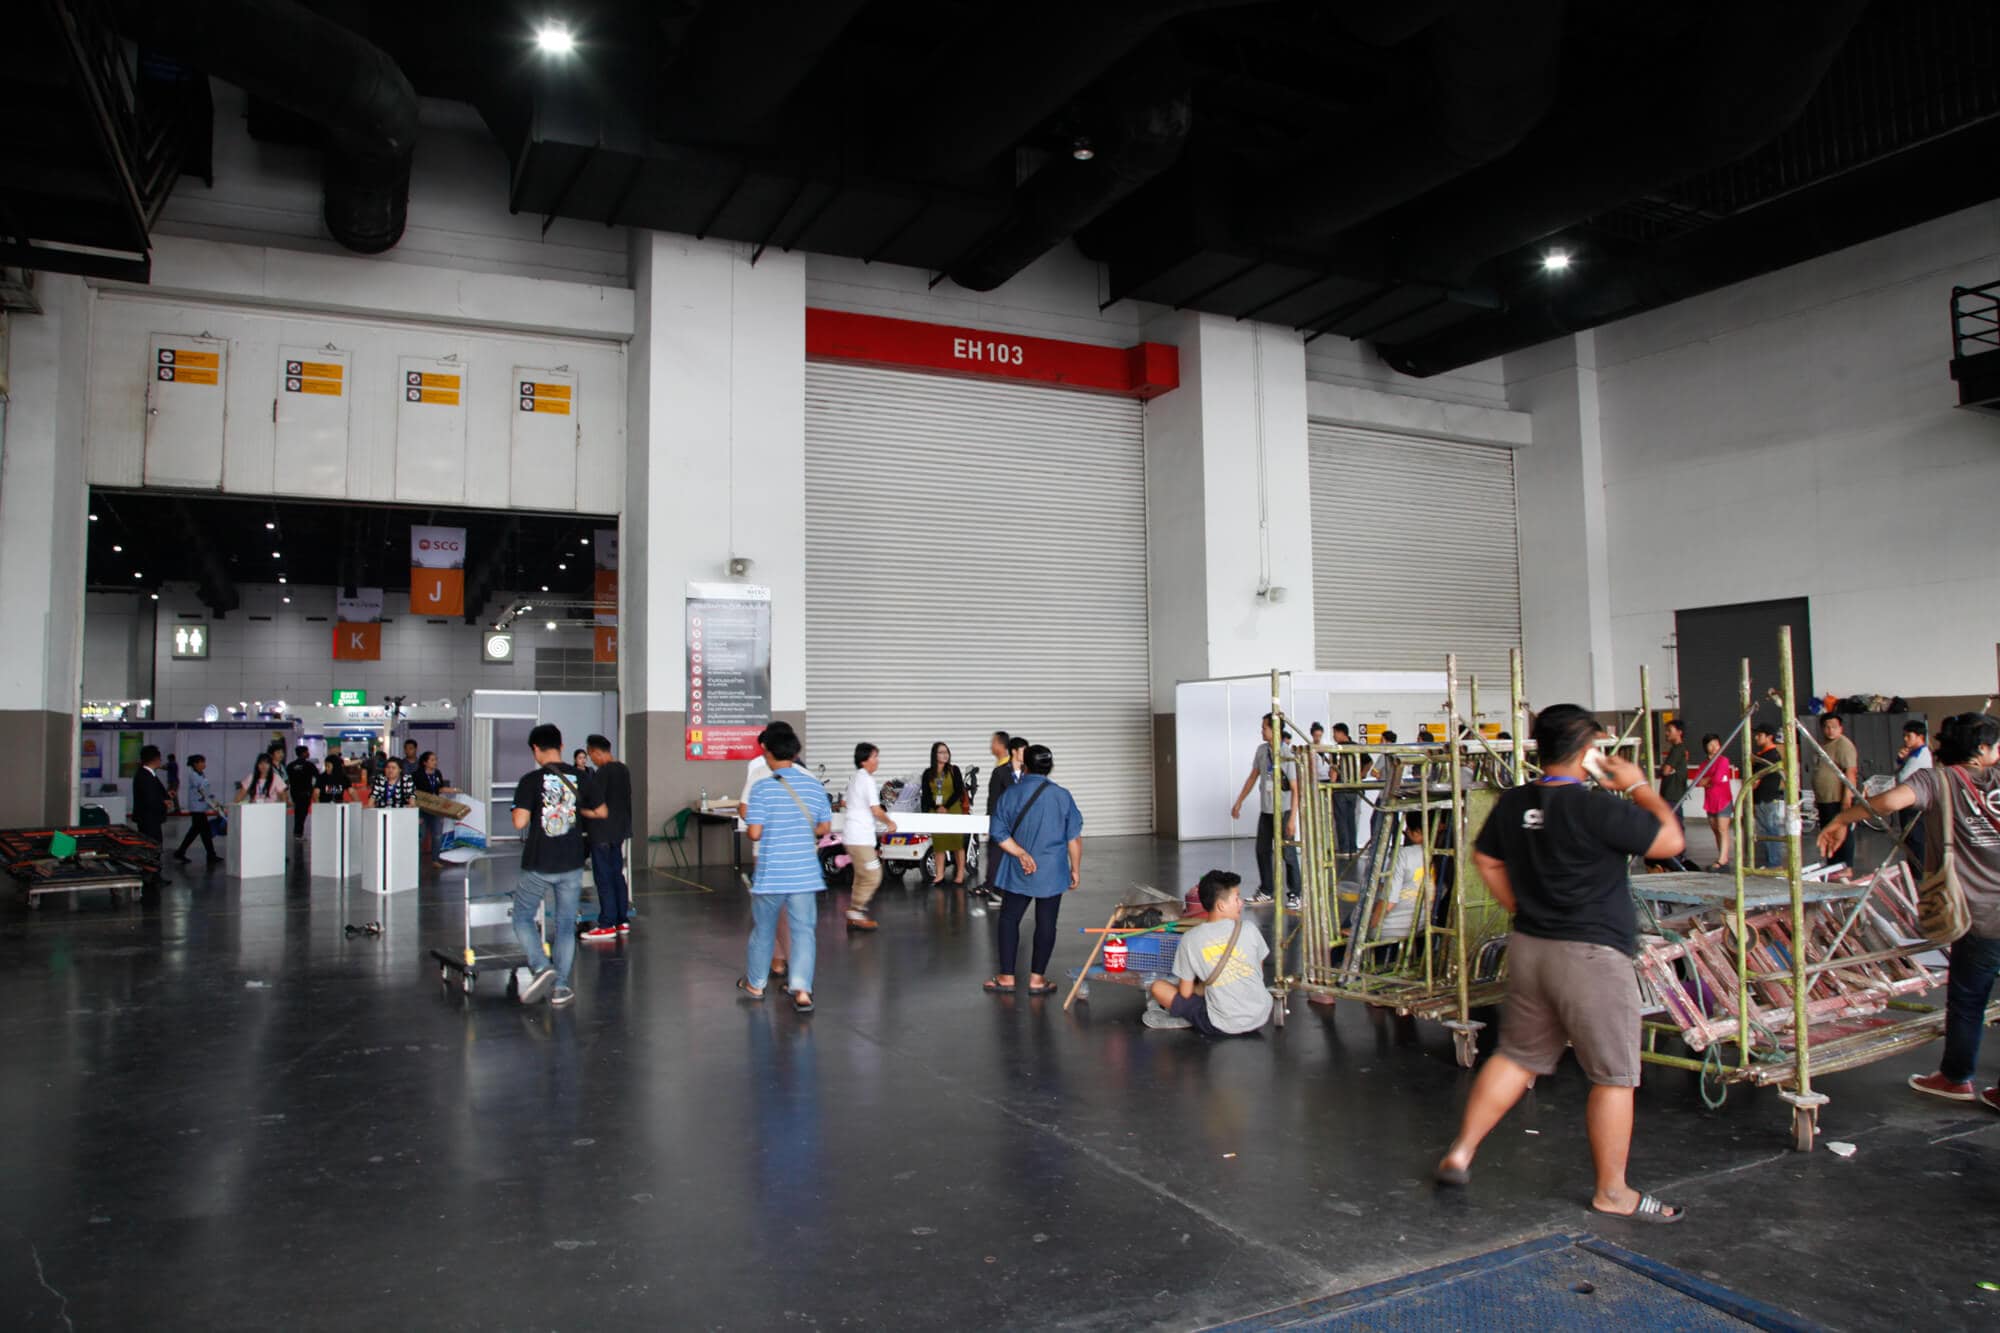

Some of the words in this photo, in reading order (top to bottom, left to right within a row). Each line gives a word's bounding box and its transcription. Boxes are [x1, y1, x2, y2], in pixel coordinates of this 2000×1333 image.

[432, 540, 459, 551] SCG
[428, 580, 442, 603] J
[351, 632, 365, 650] K
